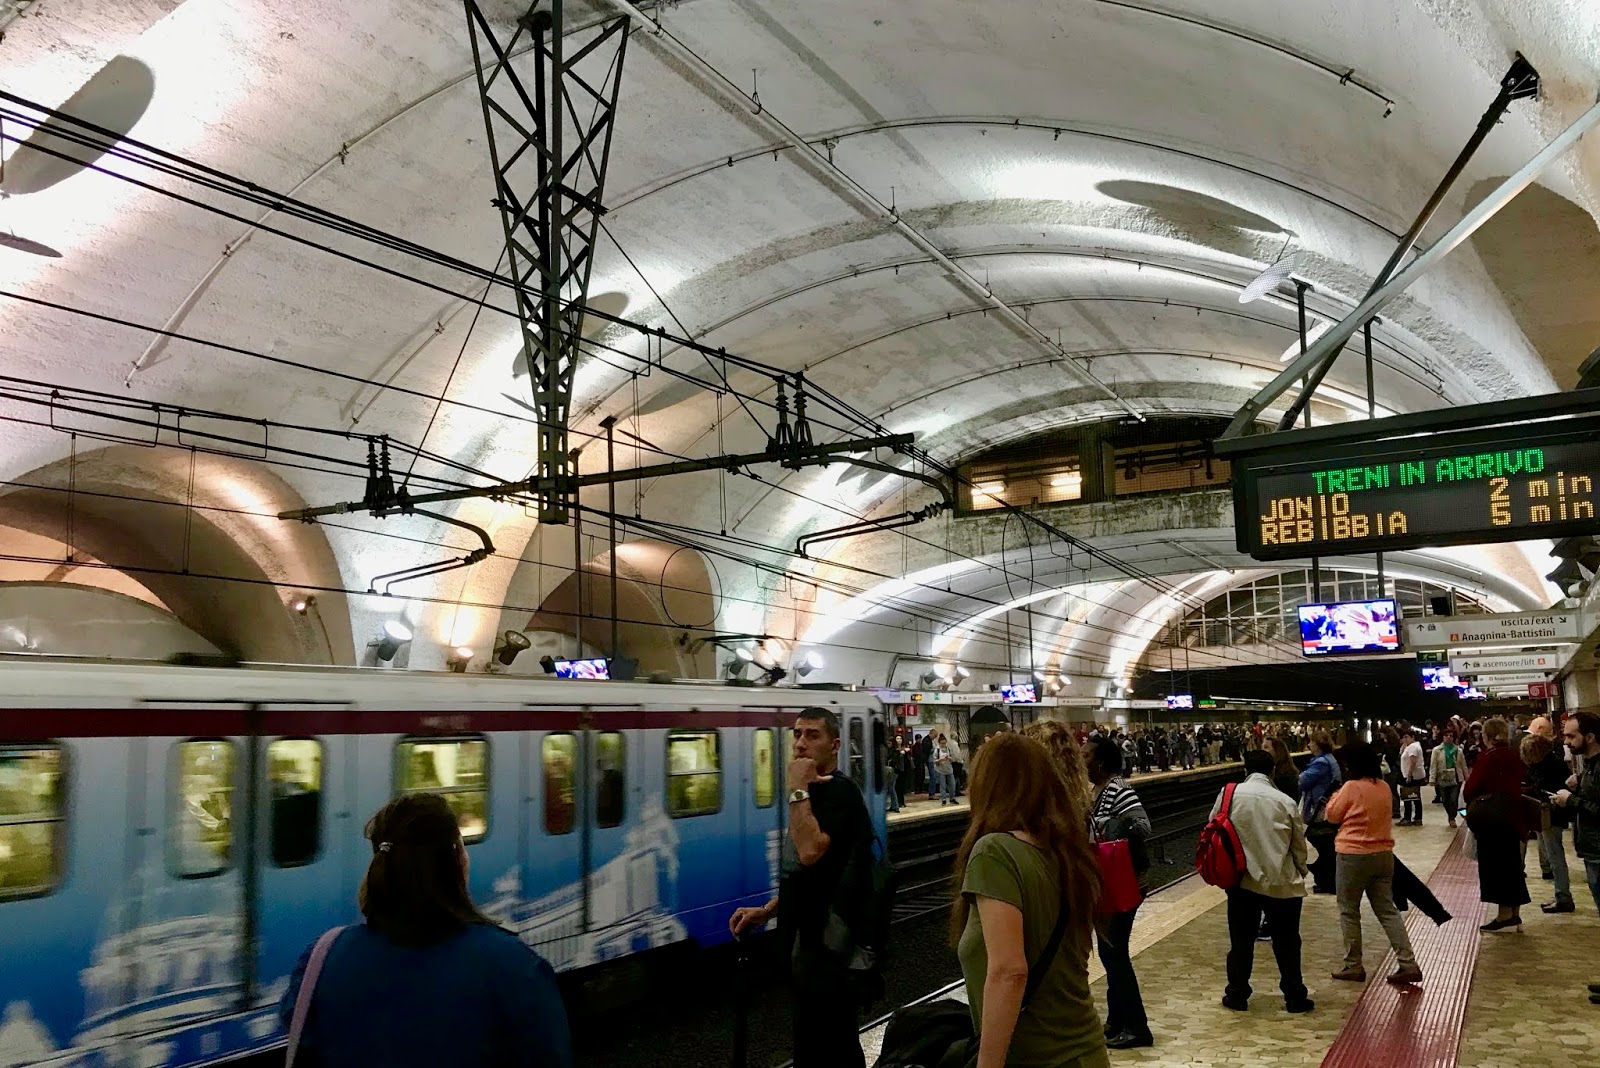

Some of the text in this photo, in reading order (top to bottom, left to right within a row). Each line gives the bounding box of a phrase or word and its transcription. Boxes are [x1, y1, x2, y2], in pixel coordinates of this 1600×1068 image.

[1312, 448, 1544, 494] TRENI IN ARRIVO
[1489, 471, 1593, 502] 2 min
[1261, 493, 1349, 523] JONIO
[1491, 497, 1594, 526] 5 min
[1261, 511, 1408, 546] REBIBBIA
[1462, 628, 1556, 642] Anagnina-Battistini
[1501, 616, 1555, 627] uscita/exit
[1482, 658, 1535, 668] ascensore/lift
